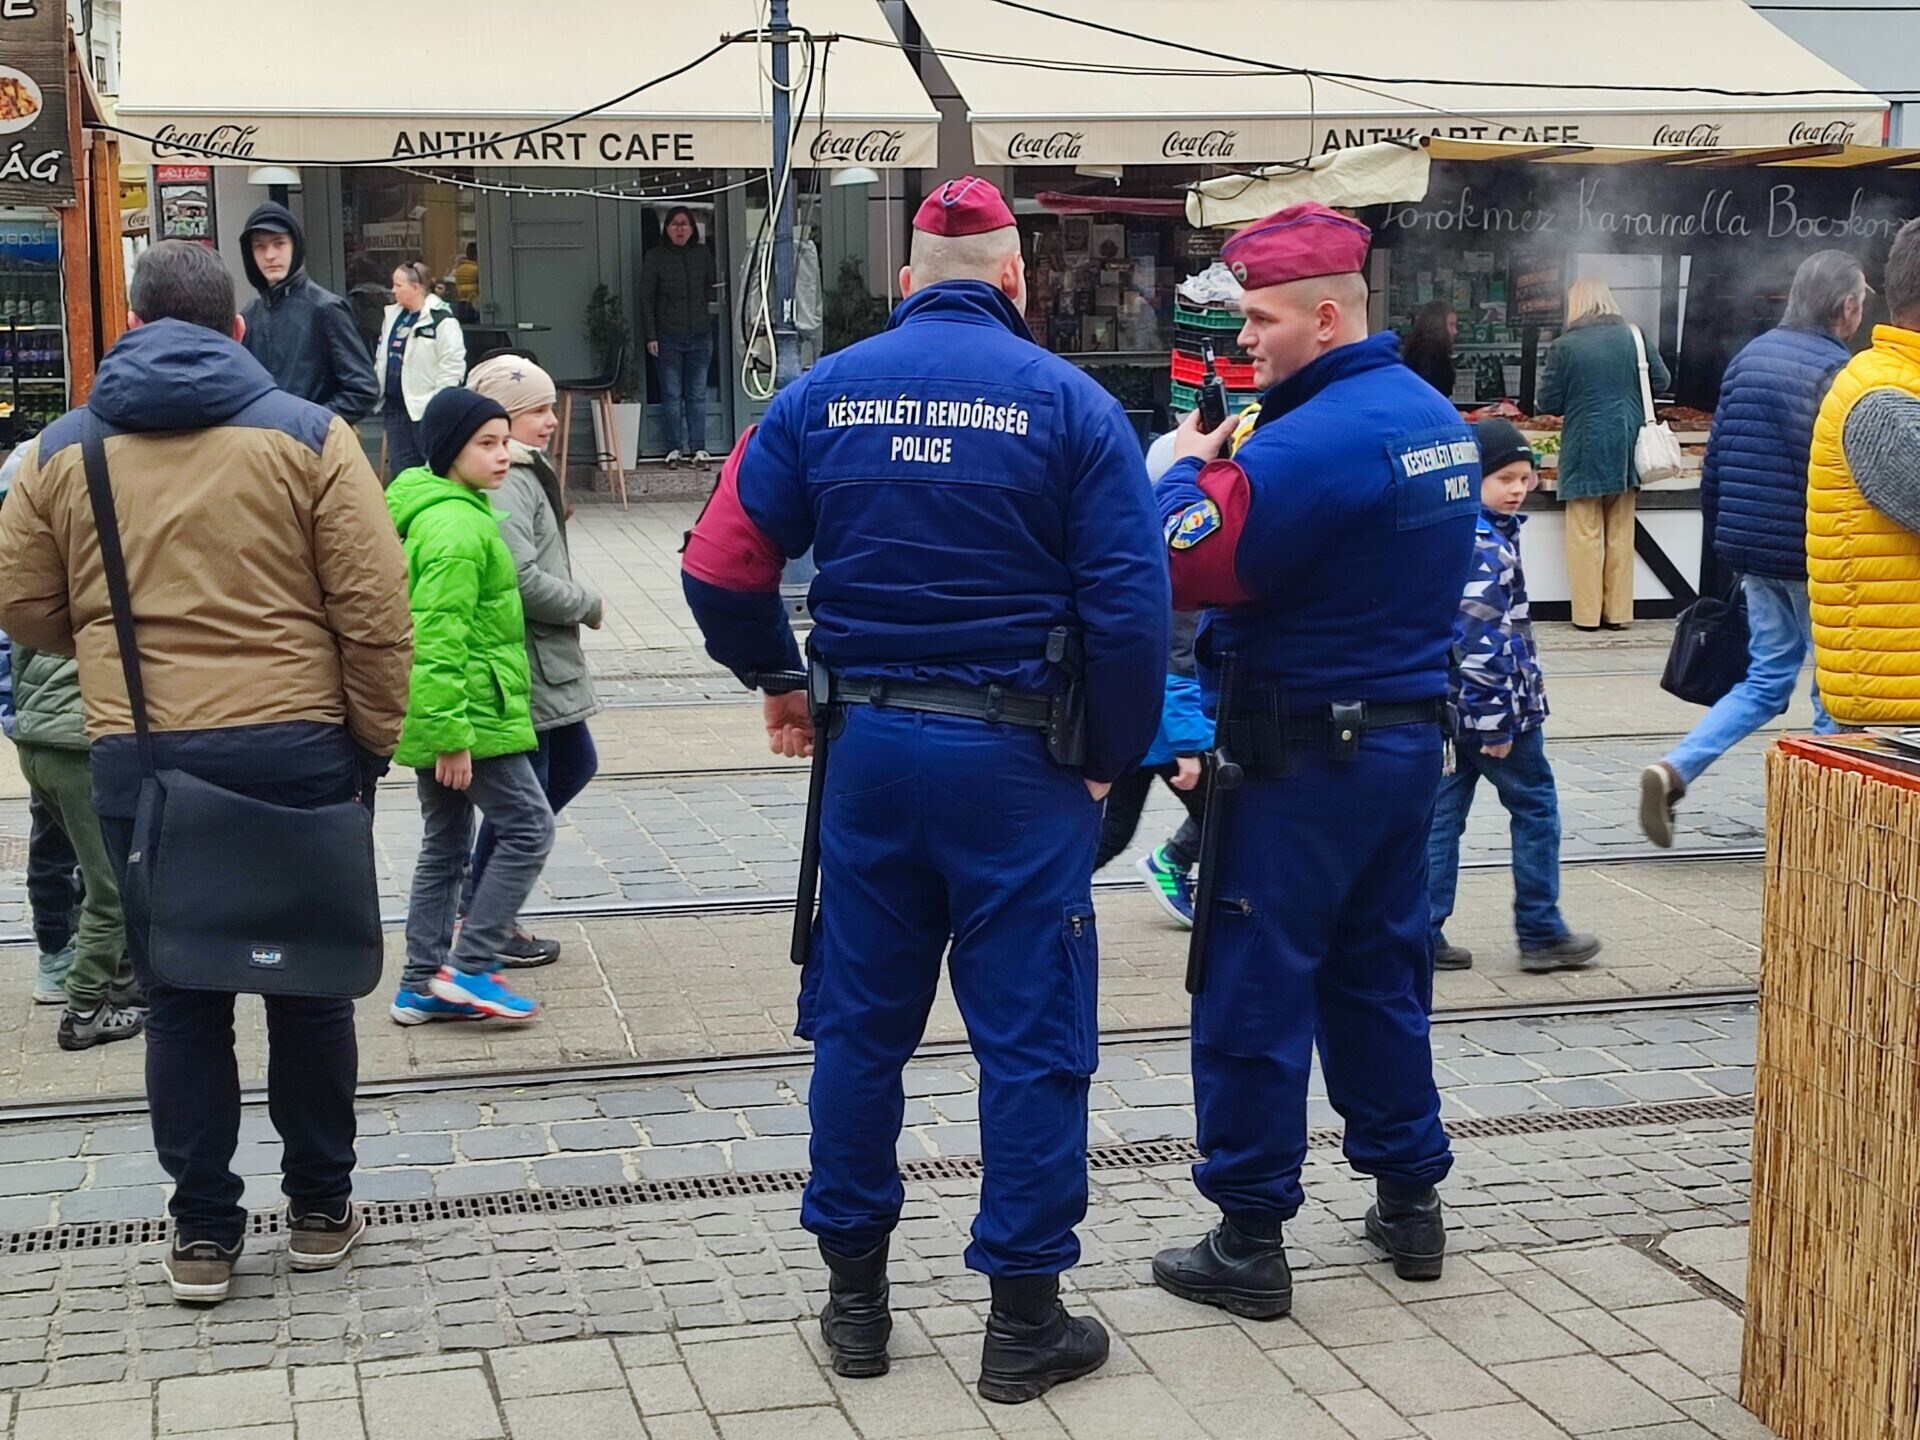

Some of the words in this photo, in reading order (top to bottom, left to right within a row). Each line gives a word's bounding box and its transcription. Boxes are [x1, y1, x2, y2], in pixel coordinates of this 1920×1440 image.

[391, 131, 504, 160] ANTIK
[513, 133, 587, 161] ART
[599, 133, 695, 162] CAFE
[810, 129, 906, 162] Coca-Cola
[1007, 131, 1086, 159] Coca-Cola
[1162, 130, 1239, 158] Coca-Cola
[1575, 177, 1752, 237] Karamella
[1767, 183, 1906, 238] Bocskor
[0, 230, 45, 247] epsi
[827, 394, 922, 427] KÉSZENLÉTI
[925, 397, 1029, 436] RENDŐRSÉG
[890, 436, 952, 463] POLICE
